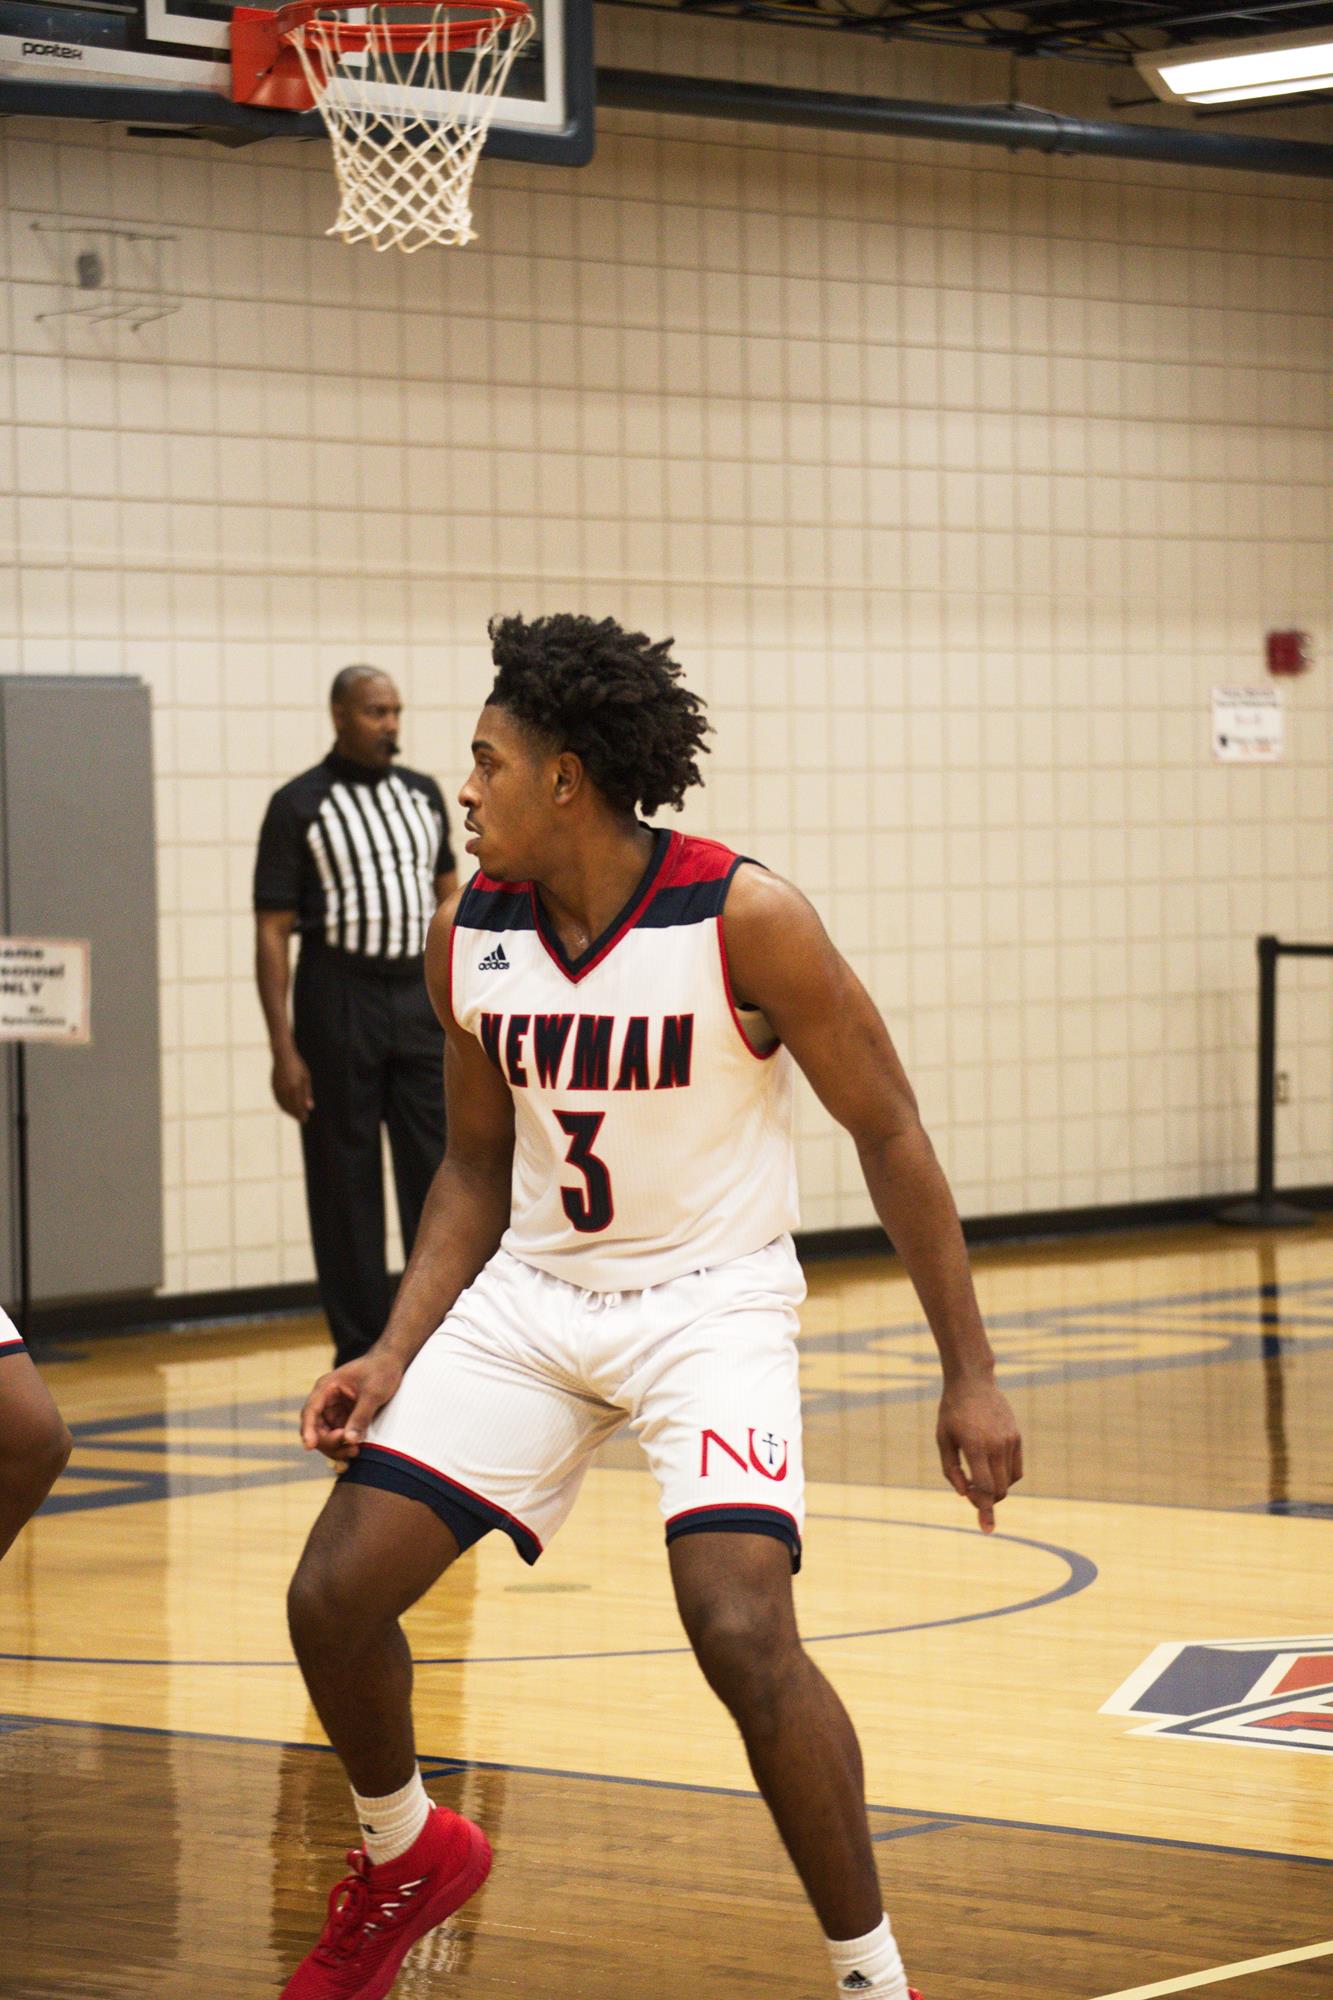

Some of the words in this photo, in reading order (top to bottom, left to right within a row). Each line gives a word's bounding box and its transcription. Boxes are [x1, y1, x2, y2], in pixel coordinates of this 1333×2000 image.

[0, 948, 45, 960] ame
[478, 959, 510, 970] adidas
[480, 1012, 694, 1091] NEWMAN
[552, 1109, 614, 1233] 3
